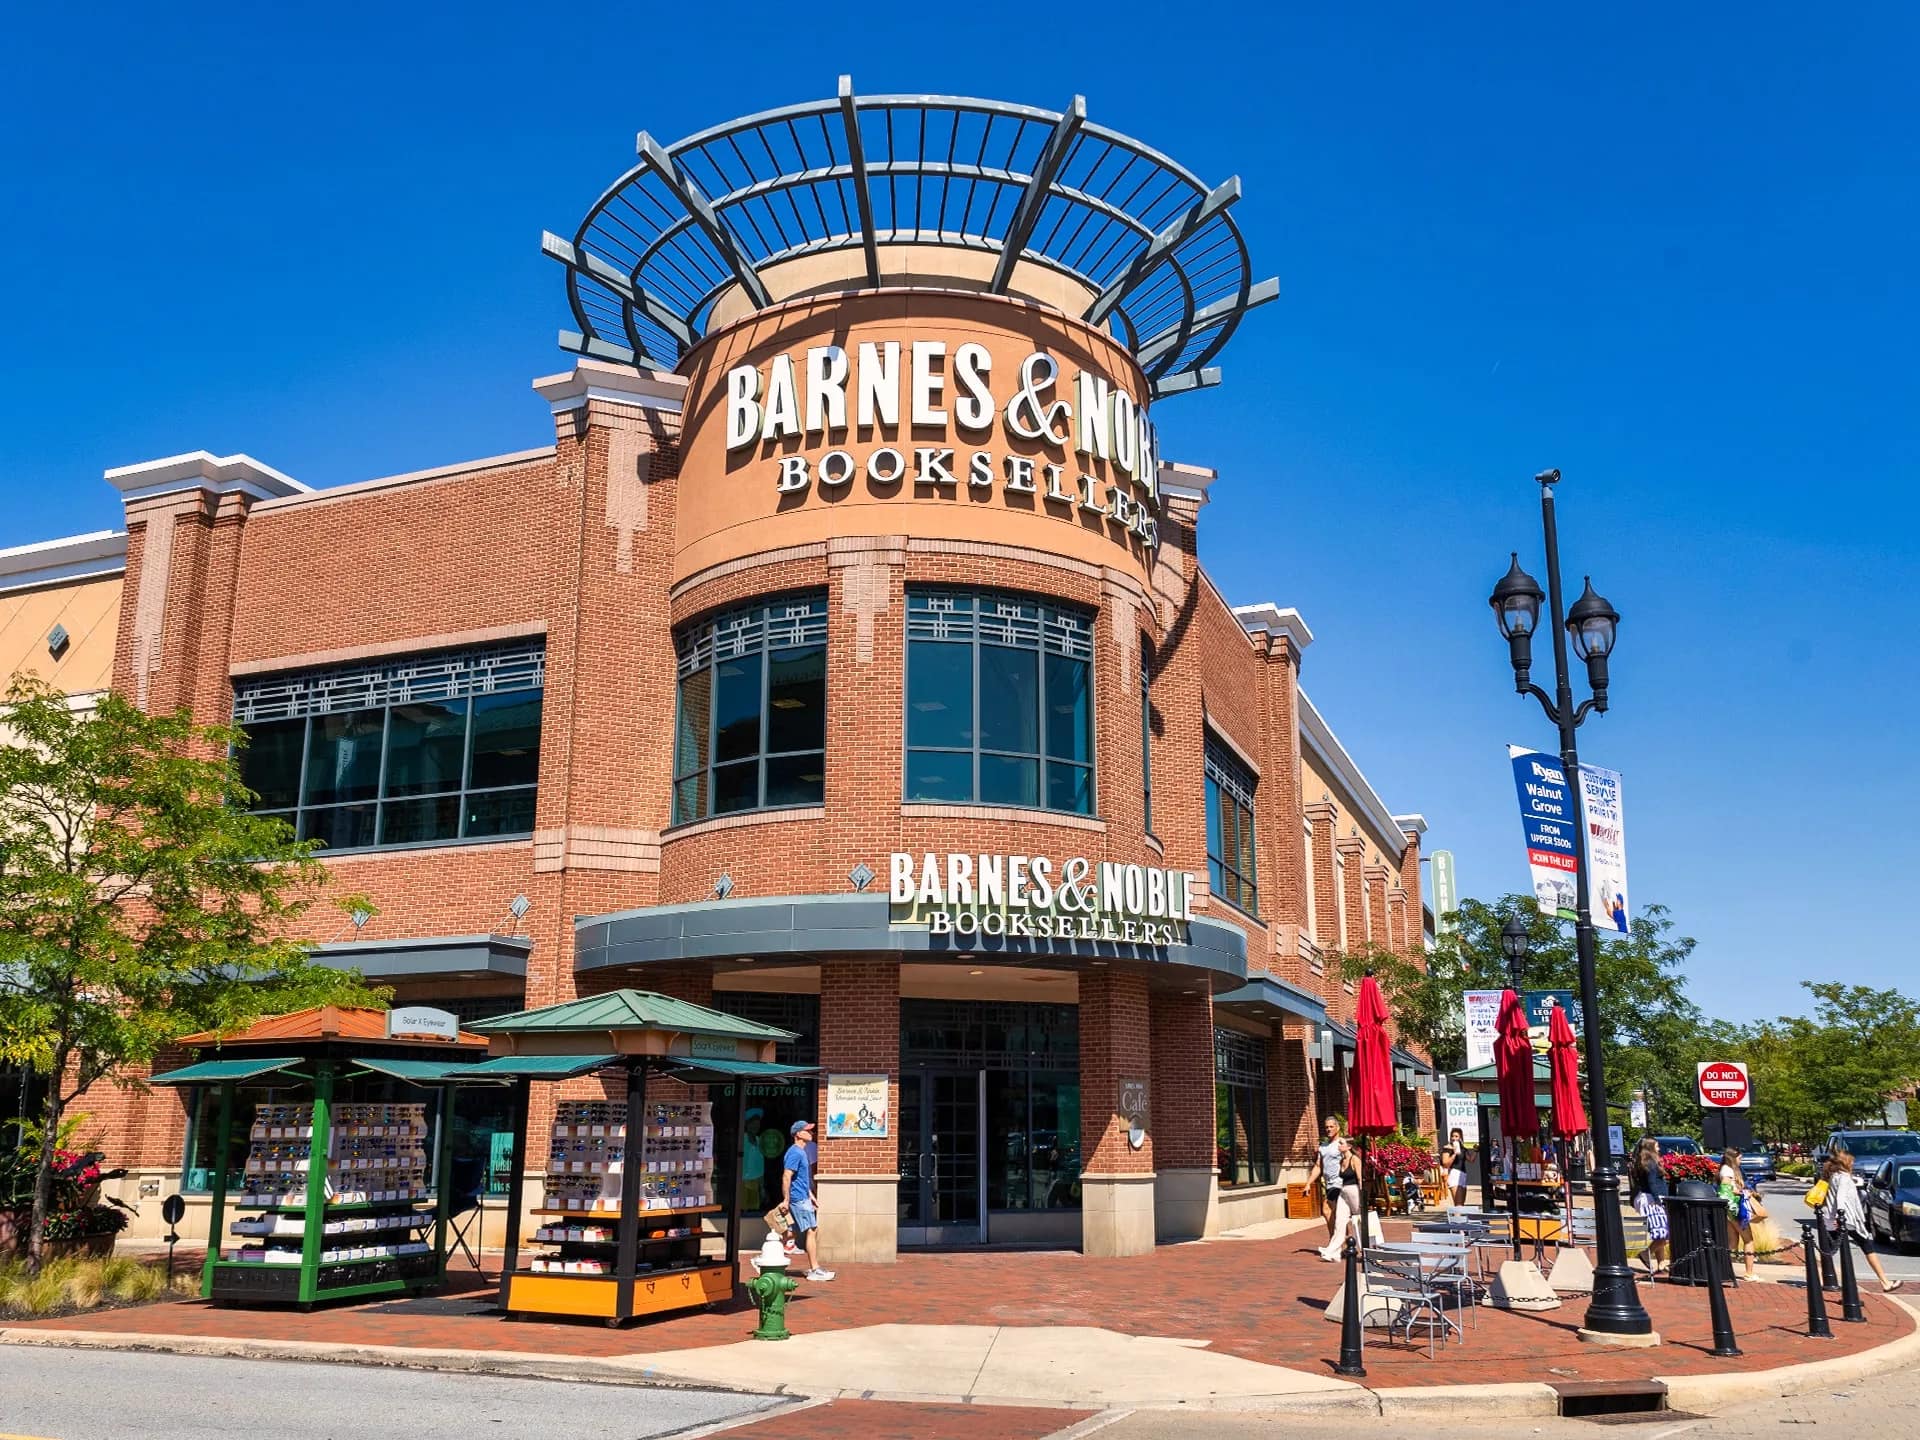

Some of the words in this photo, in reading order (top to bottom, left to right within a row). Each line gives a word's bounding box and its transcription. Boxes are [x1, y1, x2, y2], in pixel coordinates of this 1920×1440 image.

[725, 341, 994, 451] BARNES
[1004, 351, 1073, 446] &
[776, 447, 1159, 550] BOOKSELLERS
[1531, 761, 1565, 782] Ryan
[1525, 782, 1563, 801] Walnut
[1531, 798, 1562, 816] Grove
[1530, 832, 1553, 846] UPPER
[1540, 824, 1560, 836] FROM
[1532, 853, 1549, 864] JOIN
[1549, 855, 1561, 867] THE
[1561, 857, 1574, 869] LIST
[890, 852, 1052, 909] BARNES
[1057, 856, 1098, 913] &
[1099, 860, 1196, 921] NOBLE
[929, 910, 1175, 947] BOOKSELLERS
[1706, 1071, 1719, 1080] DO
[1721, 1071, 1738, 1080] NOT
[771, 1085, 807, 1097] STORE
[1710, 1090, 1738, 1099] ENTER
